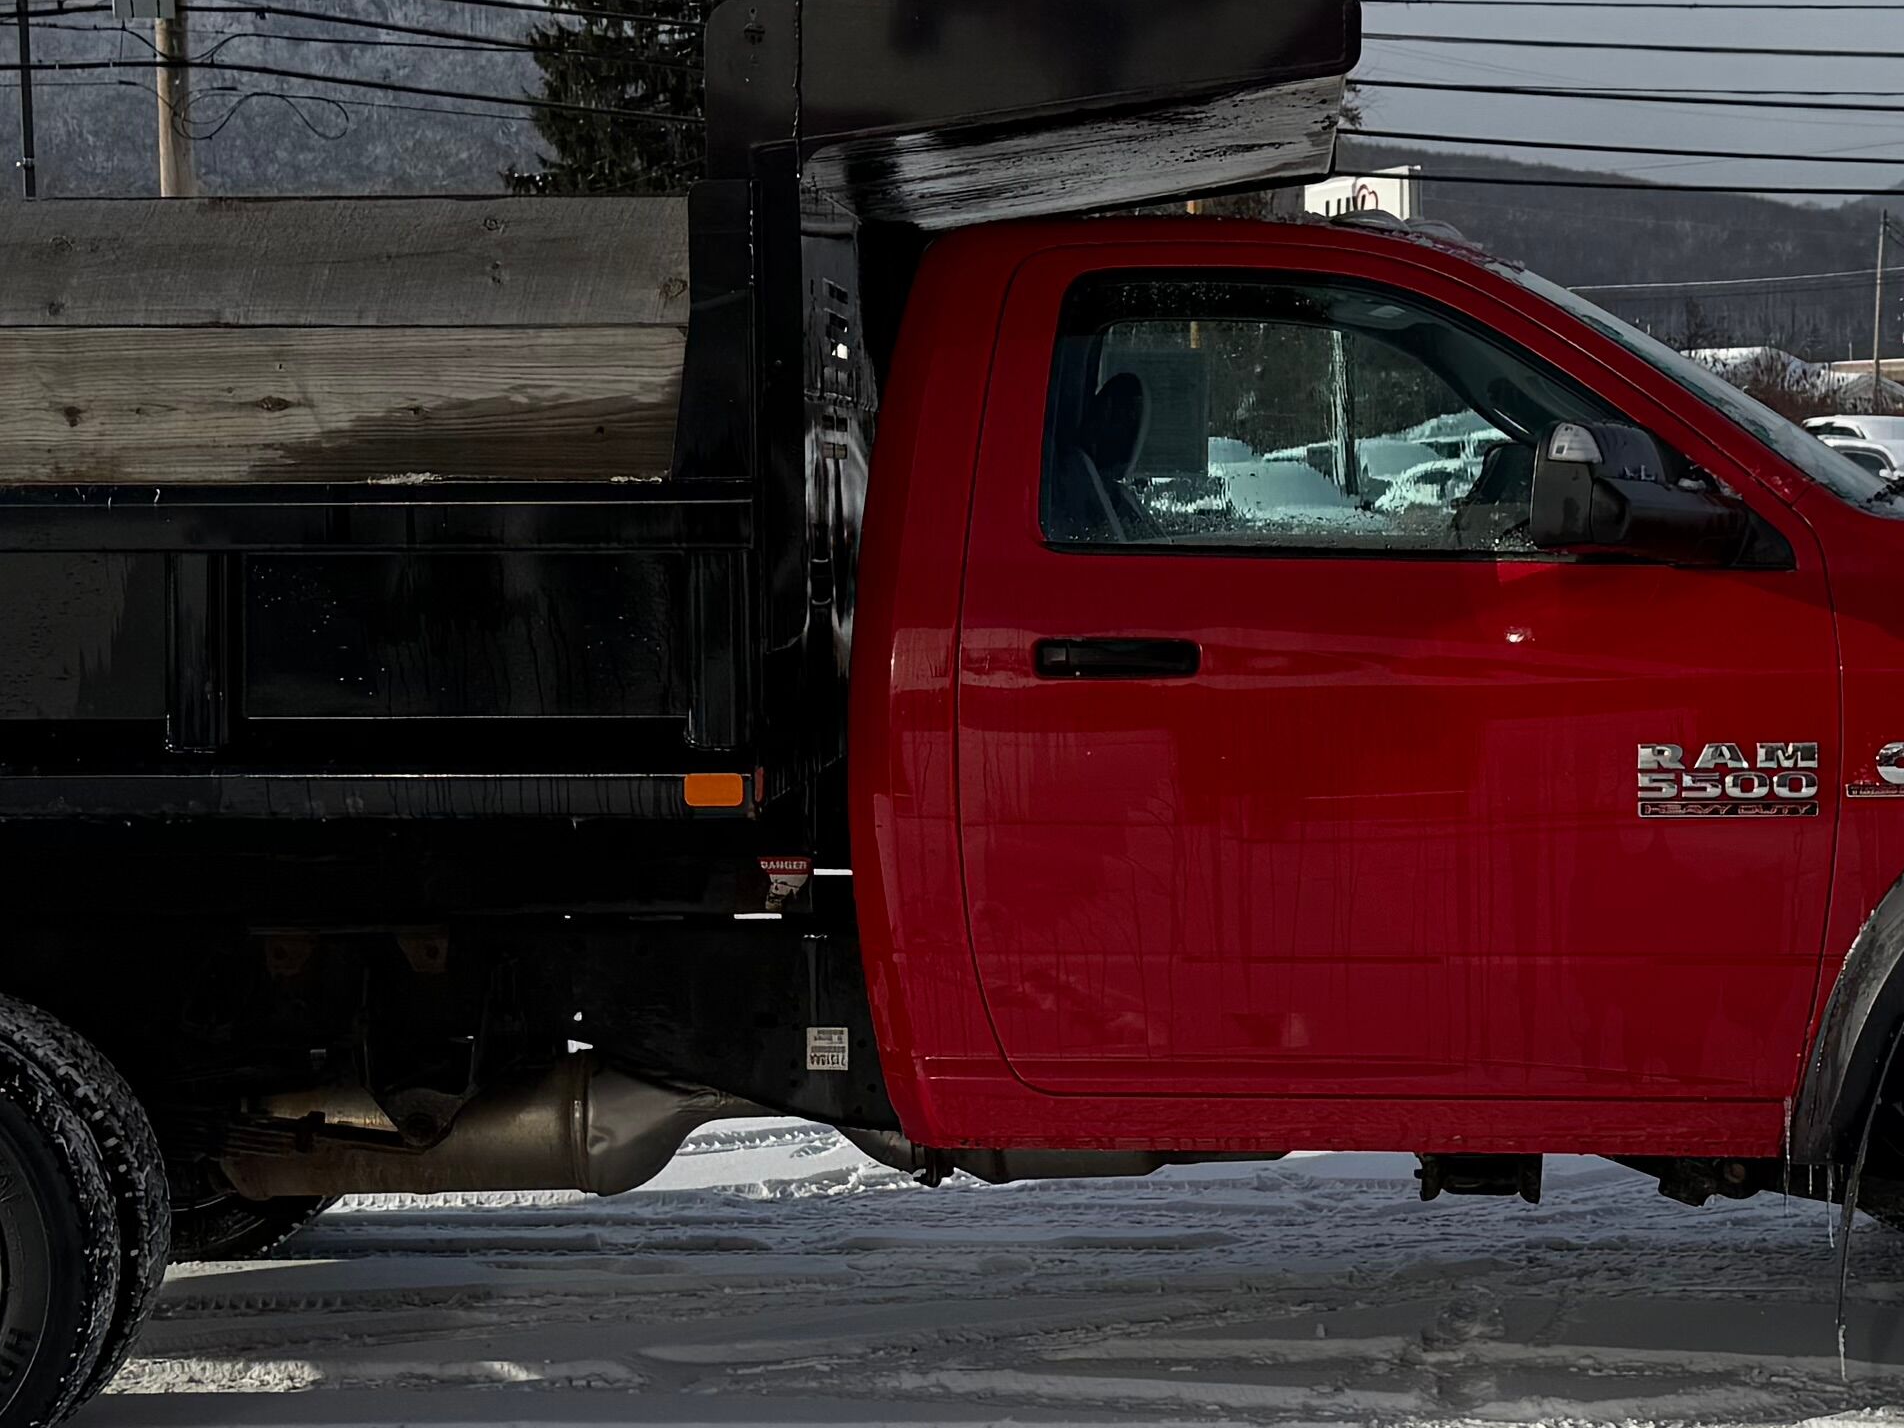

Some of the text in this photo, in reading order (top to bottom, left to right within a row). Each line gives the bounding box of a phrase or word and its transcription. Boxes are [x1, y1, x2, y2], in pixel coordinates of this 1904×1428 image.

[1637, 742, 1818, 770] RAM
[1637, 771, 1819, 799] 5500
[1644, 804, 1812, 815] HEAVY DUTY
